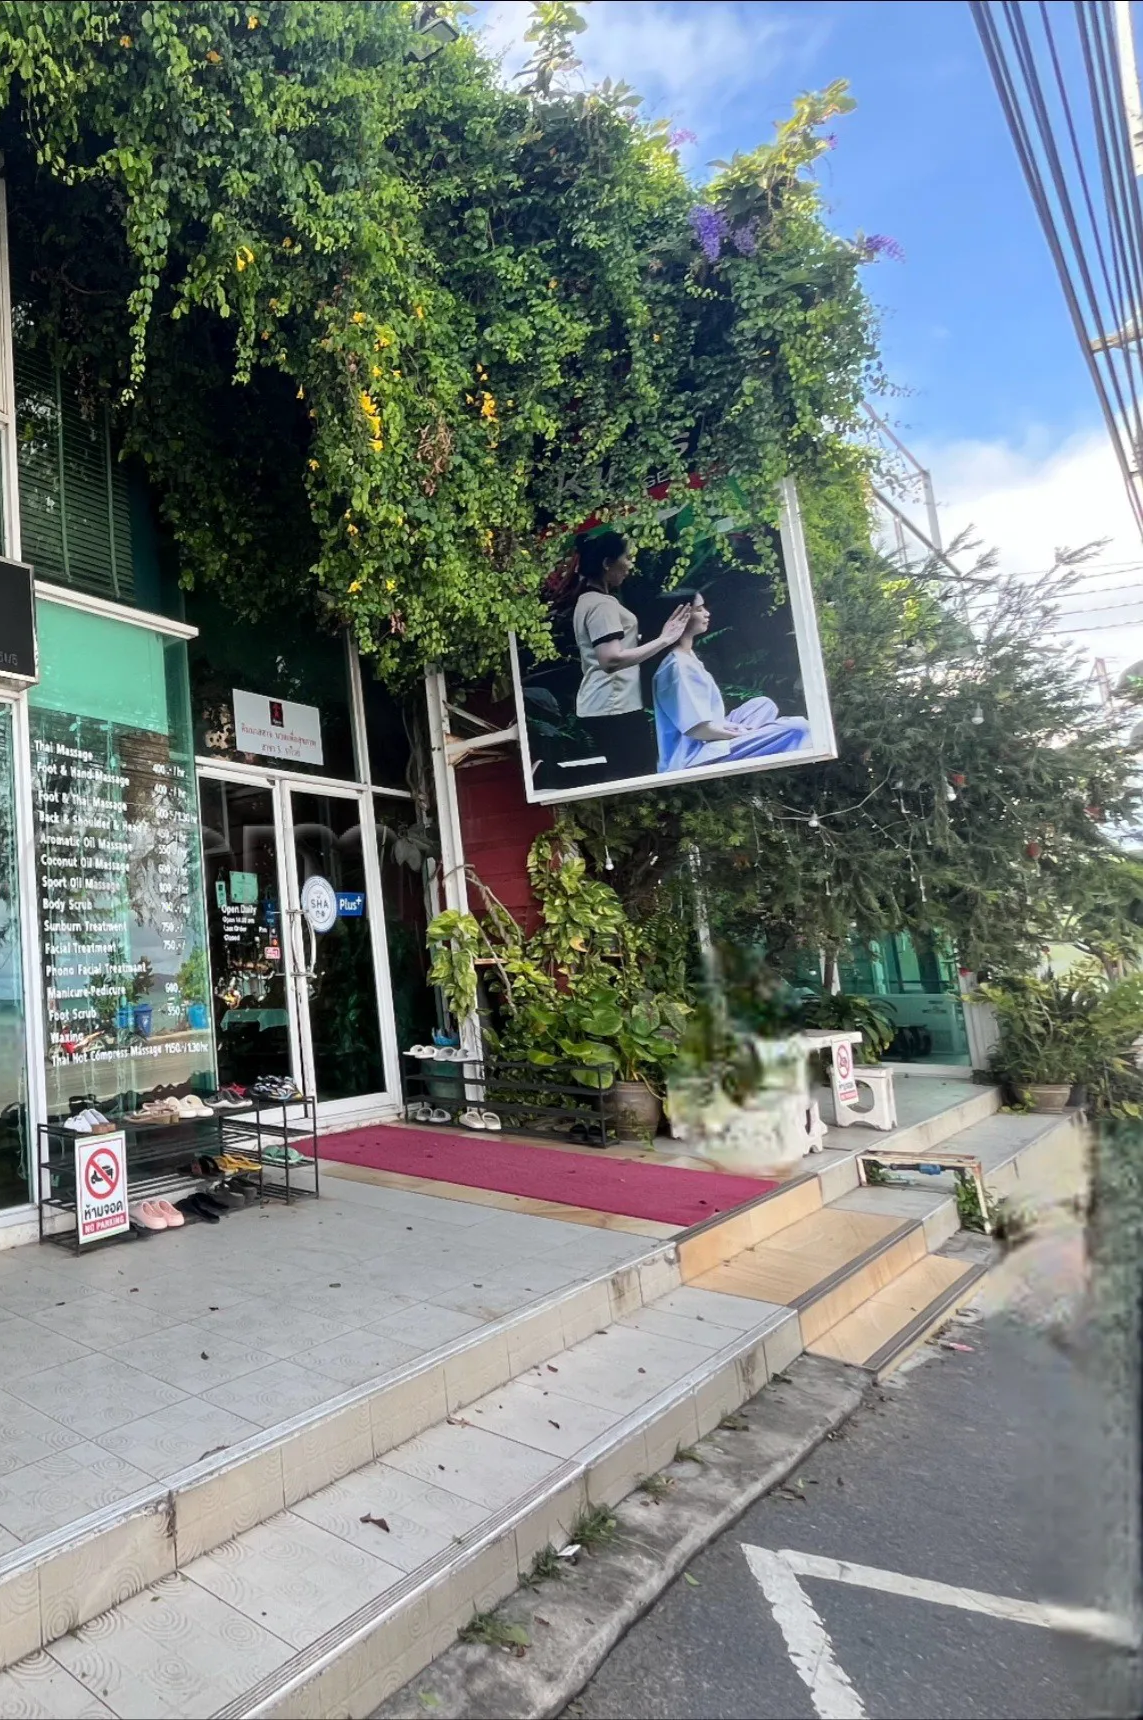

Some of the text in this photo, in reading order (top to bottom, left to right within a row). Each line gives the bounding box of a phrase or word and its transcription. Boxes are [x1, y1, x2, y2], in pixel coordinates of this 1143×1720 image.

[34, 739, 54, 753] Thai
[56, 743, 93, 762] Massage
[37, 761, 57, 775] Foot
[60, 764, 68, 776] &
[38, 789, 60, 803] Foot
[71, 793, 90, 807] Thai
[93, 796, 128, 813] Massage
[38, 810, 60, 824] Back
[63, 813, 70, 825] &
[40, 833, 80, 848] Aromatic
[83, 836, 96, 849] Oil
[98, 837, 133, 854] Massage
[40, 853, 78, 868] Coconut
[80, 857, 93, 869] Oil
[95, 858, 131, 874] Massage
[42, 875, 68, 891] Sport
[70, 877, 83, 889] Oil
[85, 879, 120, 894] Massage
[42, 898, 66, 914] Body
[68, 898, 93, 911] Scrub
[221, 904, 240, 916] Open
[240, 905, 257, 916] Daily
[311, 899, 329, 908] SHA
[43, 919, 82, 932] Sunburn
[84, 920, 128, 932] Treatment
[45, 942, 70, 955] Facial
[72, 942, 117, 954] Treatment
[78, 963, 102, 976] Facial
[104, 961, 148, 974] Treatment
[49, 1008, 71, 1022] Foot
[72, 1007, 98, 1020] Scrub
[50, 1031, 85, 1046] Waxing
[51, 1054, 70, 1068] Thai
[72, 1052, 88, 1064] Hot
[90, 1047, 128, 1063] Compress
[130, 1044, 162, 1060] Massage
[84, 1200, 124, 1220] ห้ามจอด
[84, 1214, 125, 1234] NO PARKING
